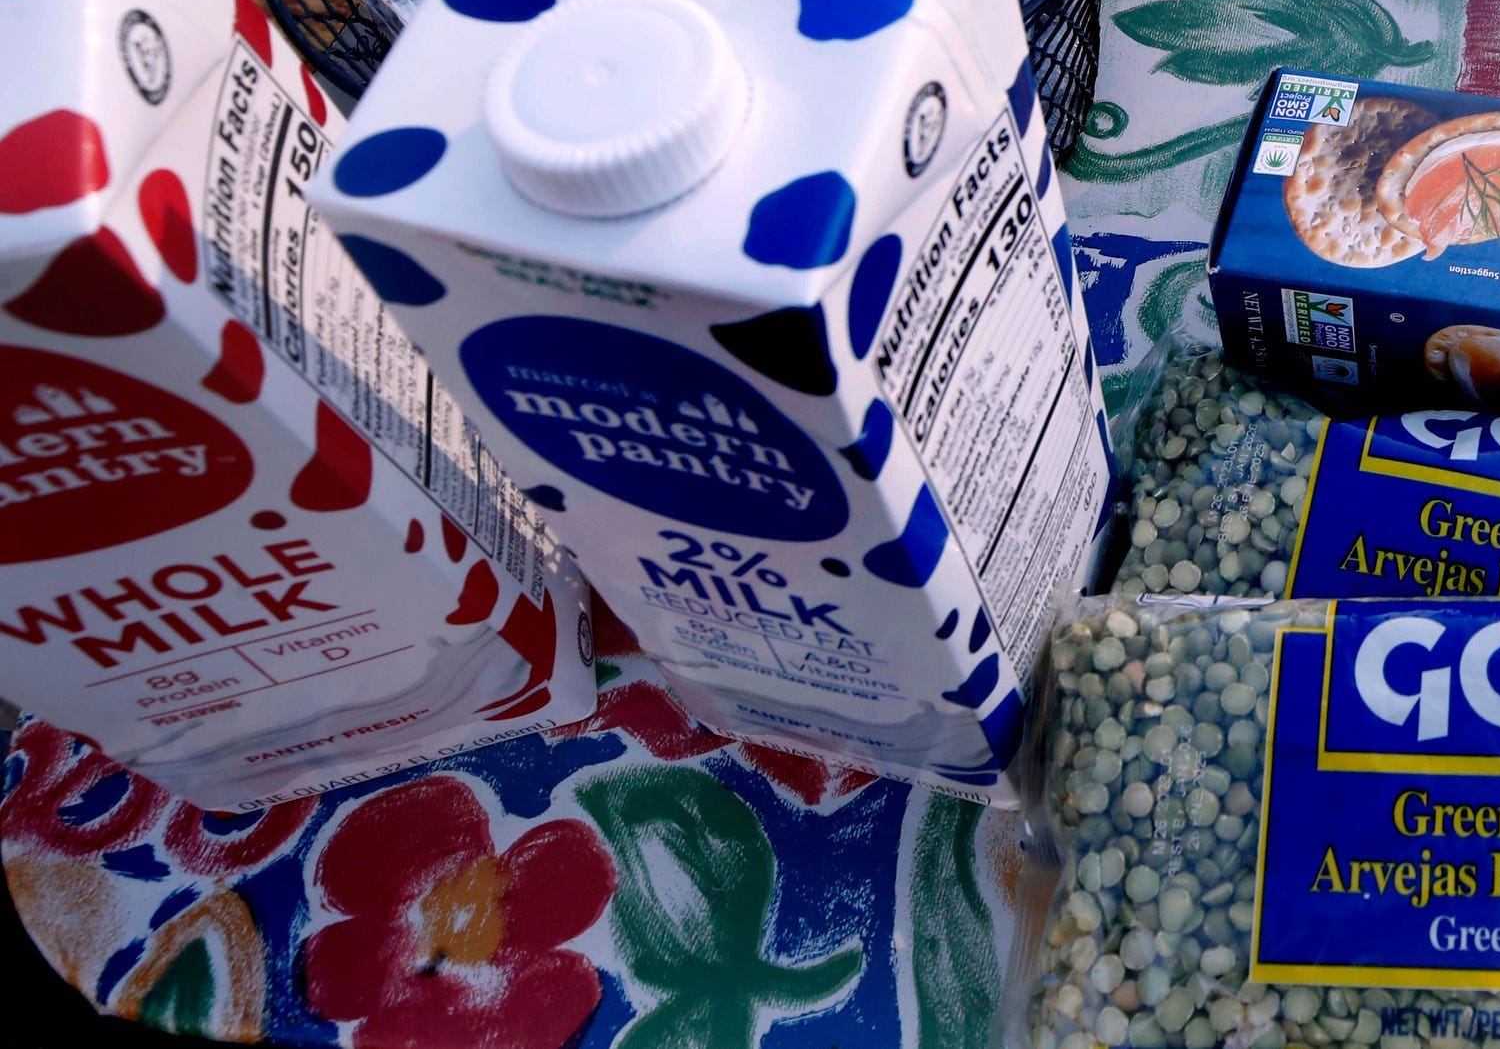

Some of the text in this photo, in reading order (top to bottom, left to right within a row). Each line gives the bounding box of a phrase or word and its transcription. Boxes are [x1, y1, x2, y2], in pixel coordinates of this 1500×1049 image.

[1277, 100, 1309, 109] GMO
[1280, 92, 1312, 102] Project
[1283, 83, 1350, 98] VERIFIED
[1275, 108, 1306, 118] NON
[210, 60, 259, 294] Nutrition Facts
[283, 120, 319, 363] Calories 150
[876, 128, 1011, 382] Nutrition Facts
[1448, 264, 1500, 281] Suggestion
[913, 193, 1033, 443] Calories 130
[1295, 293, 1311, 343] VERIFIED
[1325, 325, 1338, 348] GMO
[1338, 326, 1351, 350] NON
[505, 389, 794, 474] modern
[570, 430, 814, 510] pantry
[1236, 454, 1249, 479] JAN
[1250, 445, 1265, 472] 2025
[658, 530, 788, 588] 2%
[1337, 532, 1485, 598] Arvejas
[0, 539, 336, 645] WHOLE
[638, 556, 853, 636] MILK
[70, 580, 340, 668] MILK
[262, 618, 380, 659] Vitamin
[145, 669, 201, 691] 8g
[804, 652, 871, 675] A&D
[136, 674, 241, 710] Protein
[244, 735, 335, 764] PANTRY
[1309, 849, 1477, 908] Arvejas
